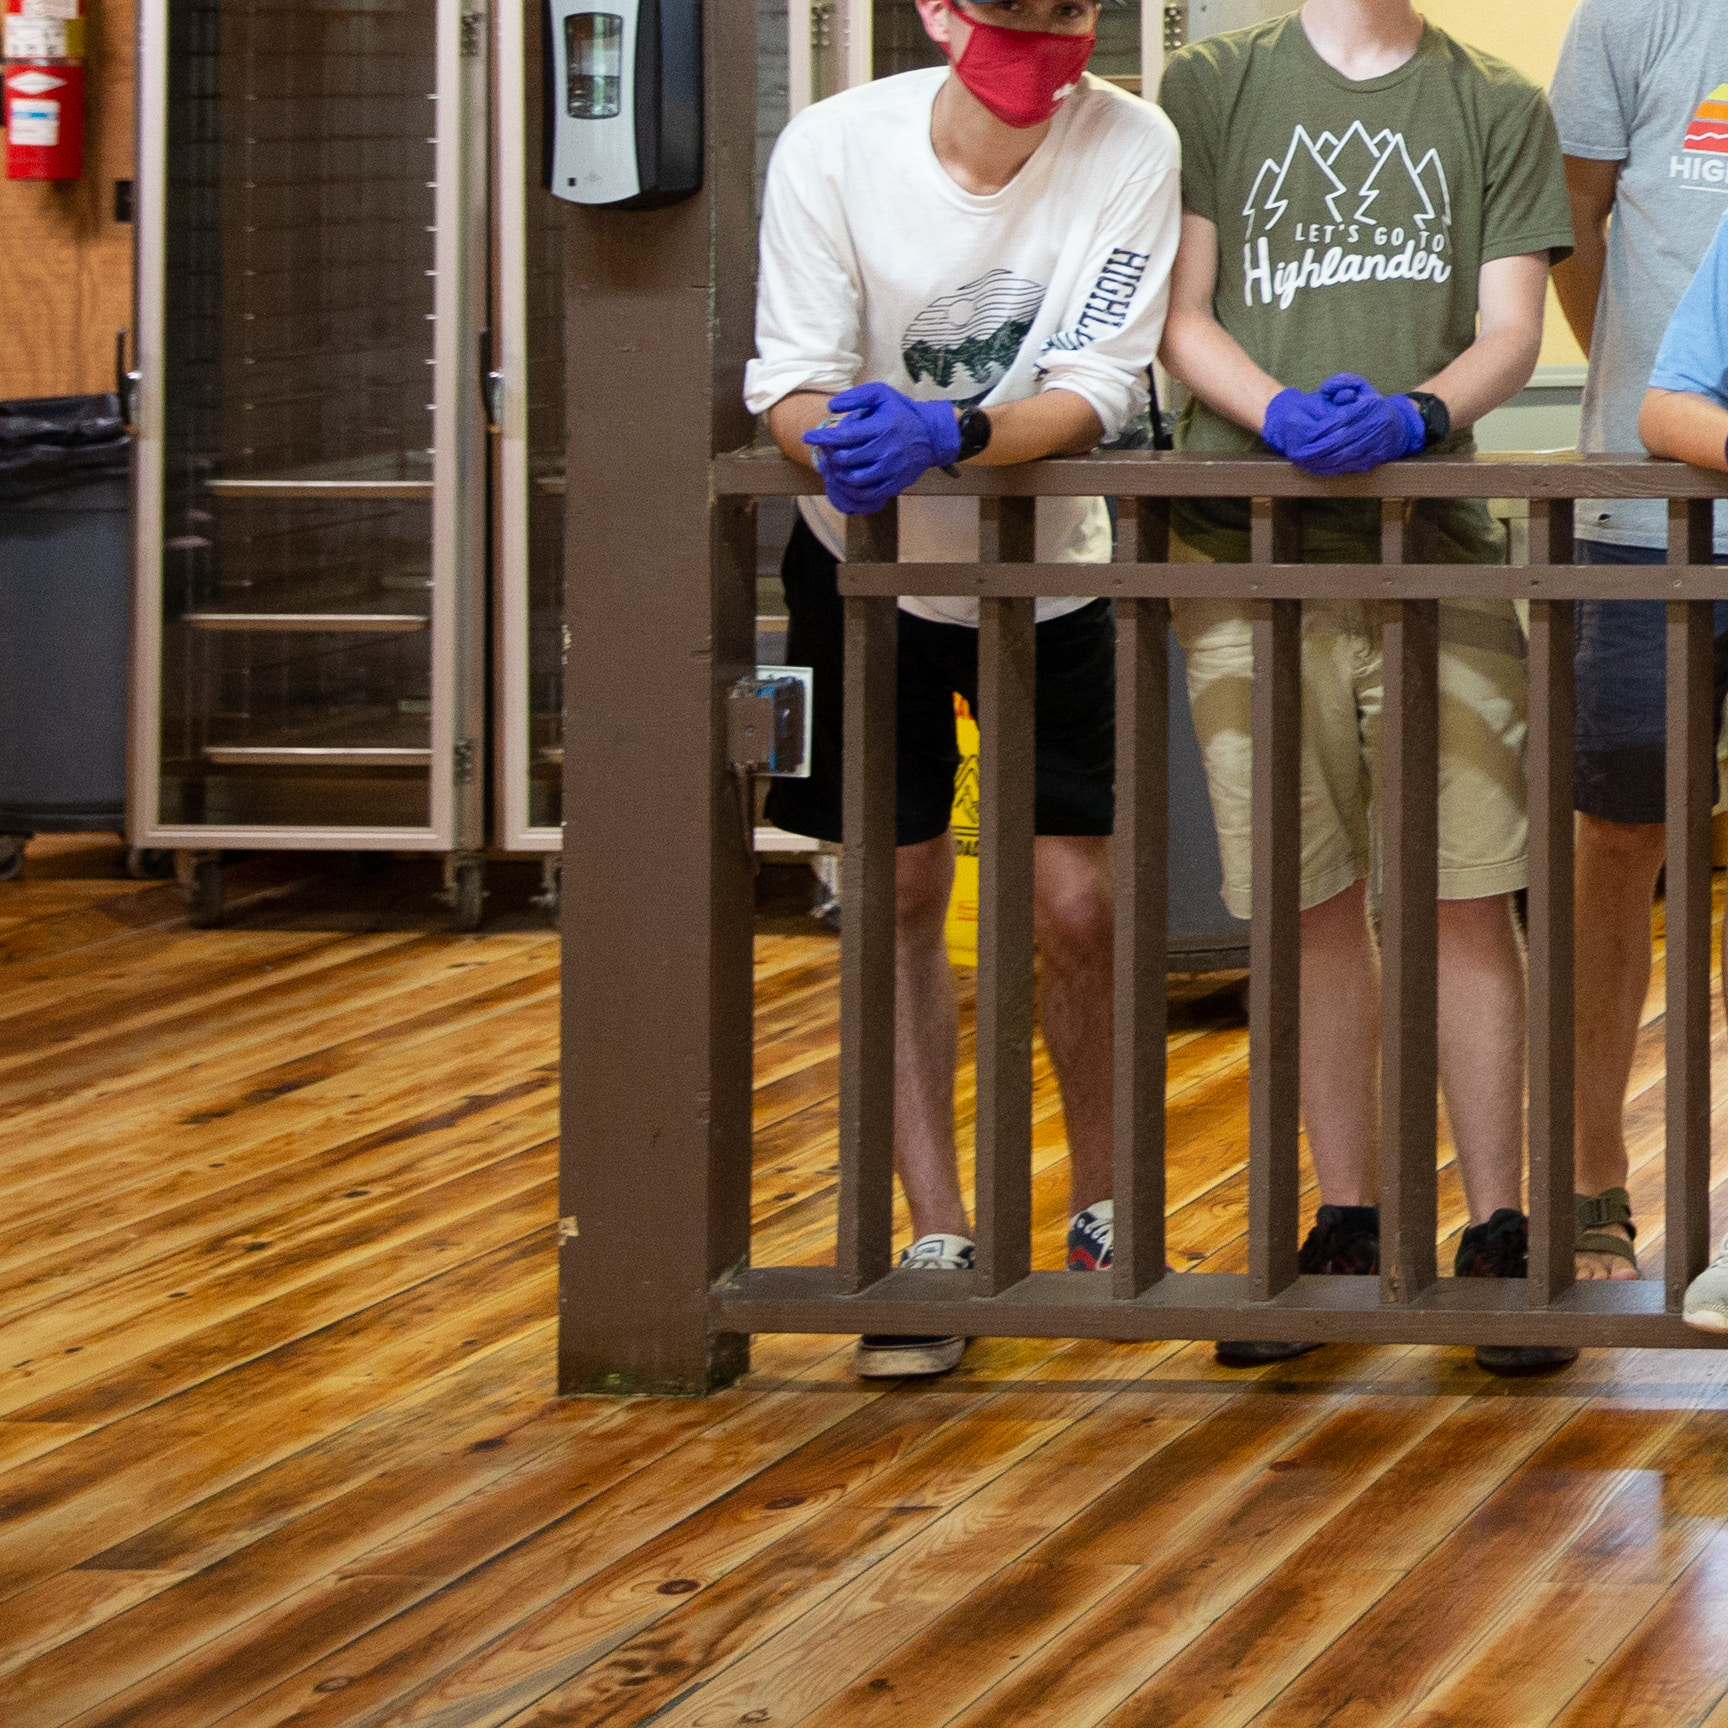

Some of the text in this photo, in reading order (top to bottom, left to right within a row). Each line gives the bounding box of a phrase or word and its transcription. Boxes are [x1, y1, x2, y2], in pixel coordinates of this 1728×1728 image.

[1295, 222, 1445, 252] LET'S GO TO
[1244, 236, 1452, 310] Highlander
